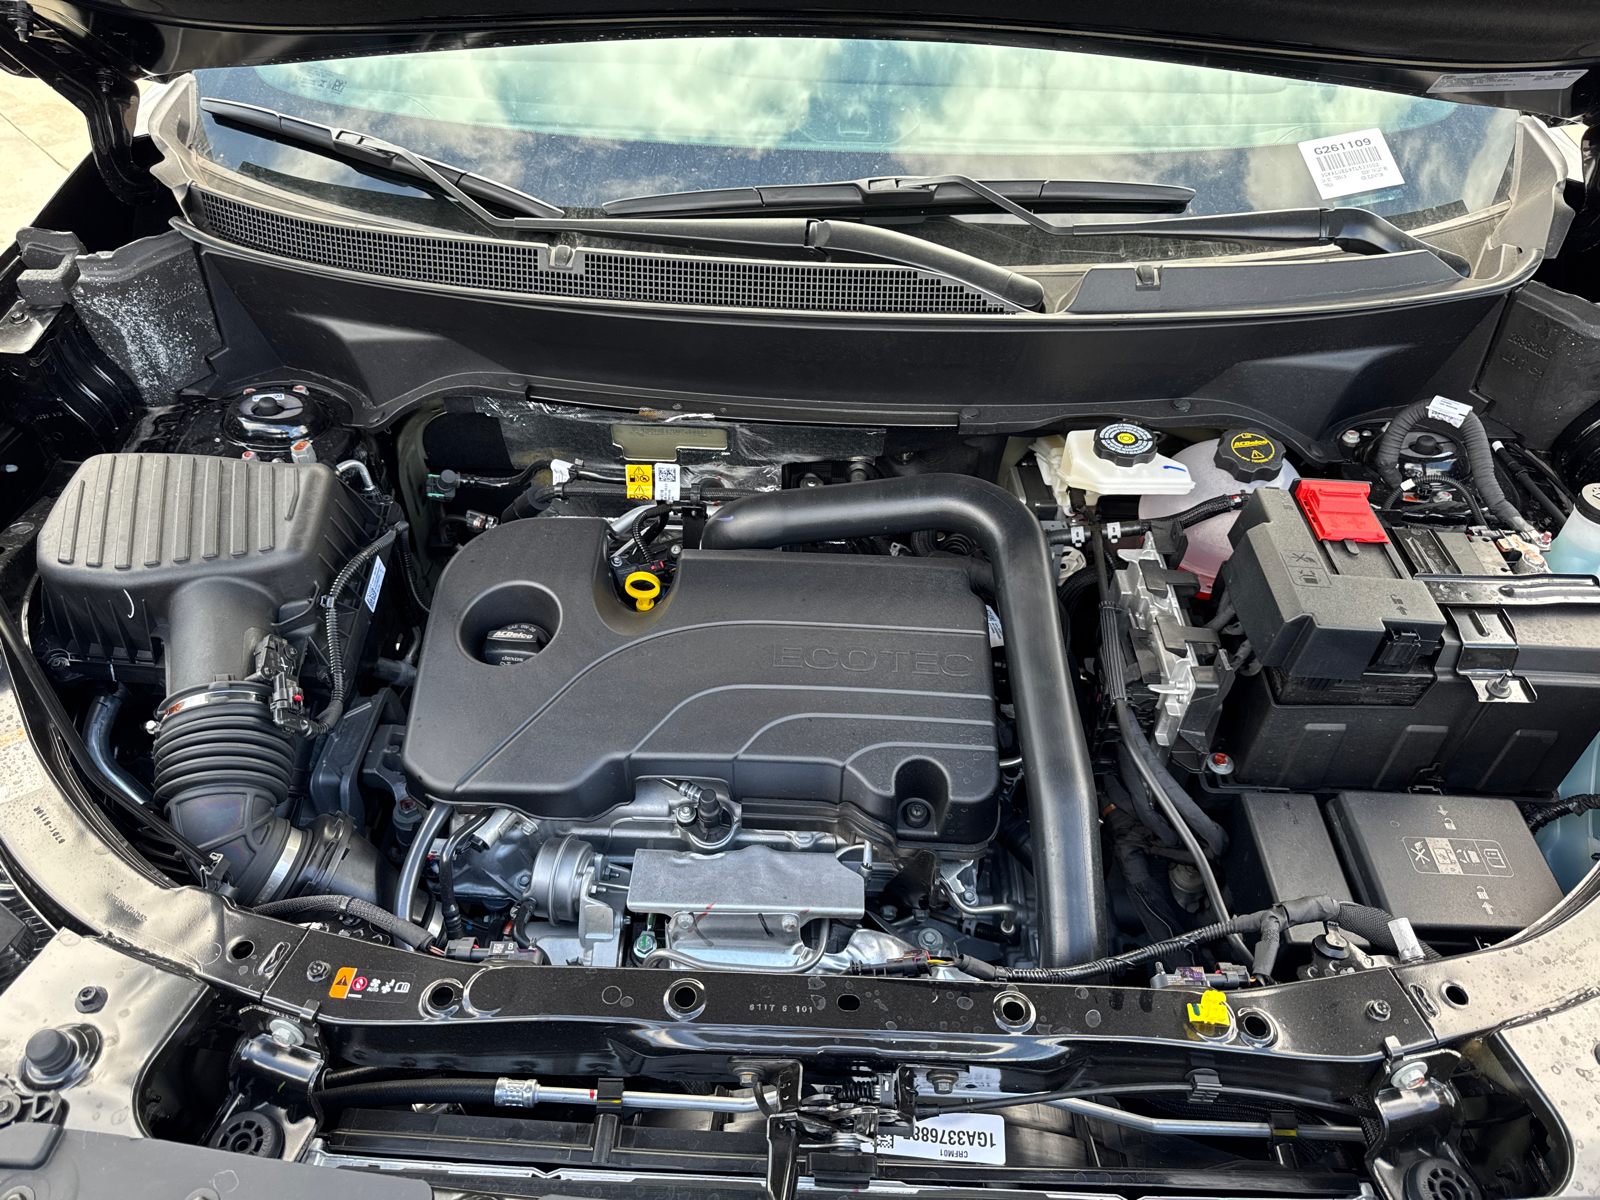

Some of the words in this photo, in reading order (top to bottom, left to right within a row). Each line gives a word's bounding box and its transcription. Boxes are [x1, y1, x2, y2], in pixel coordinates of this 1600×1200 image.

[1313, 138, 1371, 155] G261109
[492, 630, 533, 639] ACDelco
[773, 643, 975, 677] ECOTEC
[795, 1005, 813, 1014] 101
[939, 1148, 968, 1158] CRFM01
